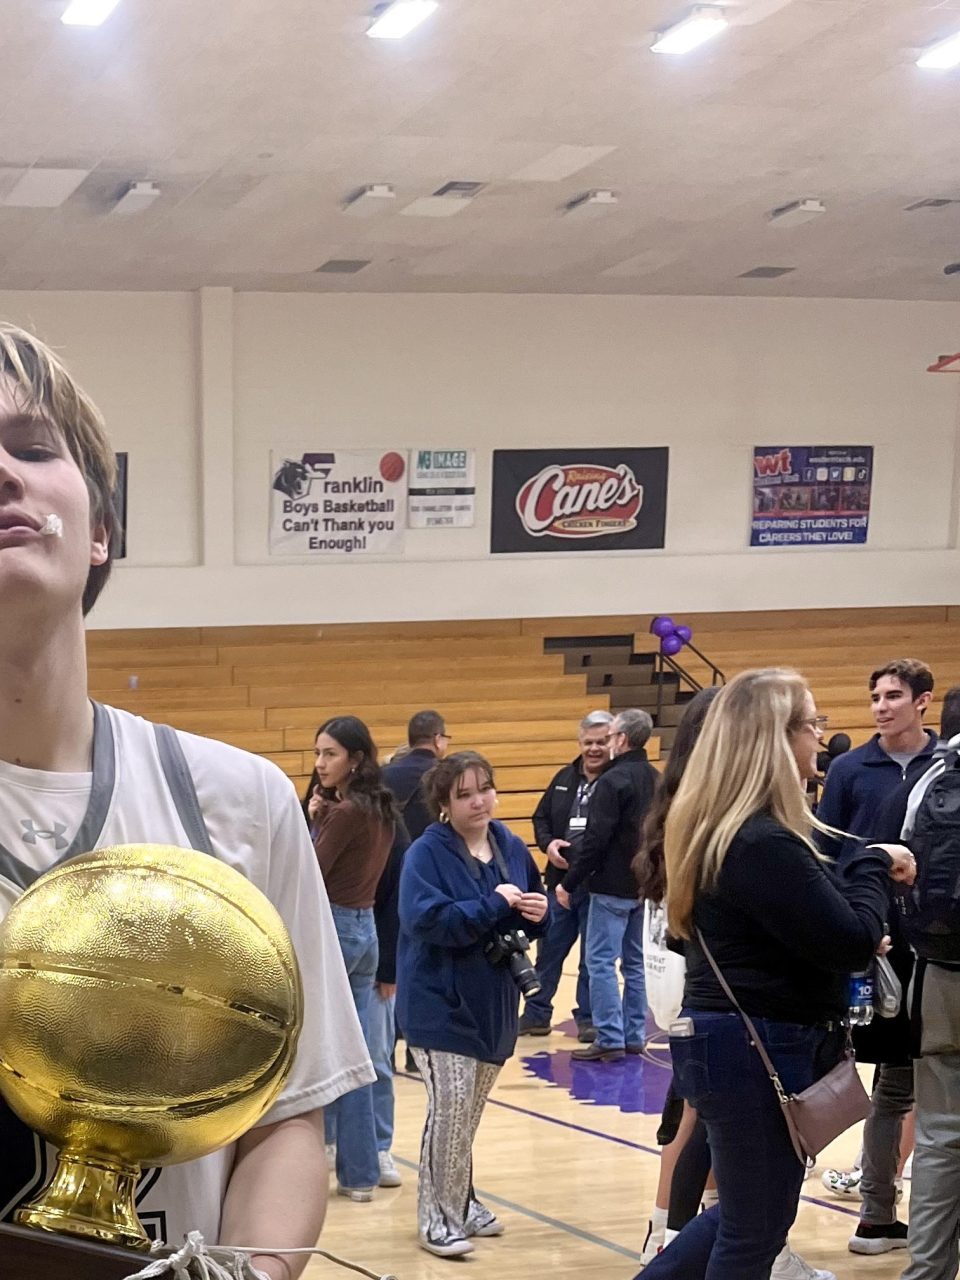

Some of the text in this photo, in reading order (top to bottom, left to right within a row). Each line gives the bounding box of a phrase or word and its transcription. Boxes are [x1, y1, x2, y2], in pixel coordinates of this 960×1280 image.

[753, 449, 792, 477] wt
[524, 468, 639, 530] Cane's
[283, 499, 319, 516] Boys
[323, 499, 394, 513] Basketball
[282, 519, 394, 534] Can't Thank you
[800, 518, 848, 529] STUDENTS
[849, 517, 867, 528] FOR
[308, 536, 367, 552] Enough!
[803, 532, 827, 541] THEY
